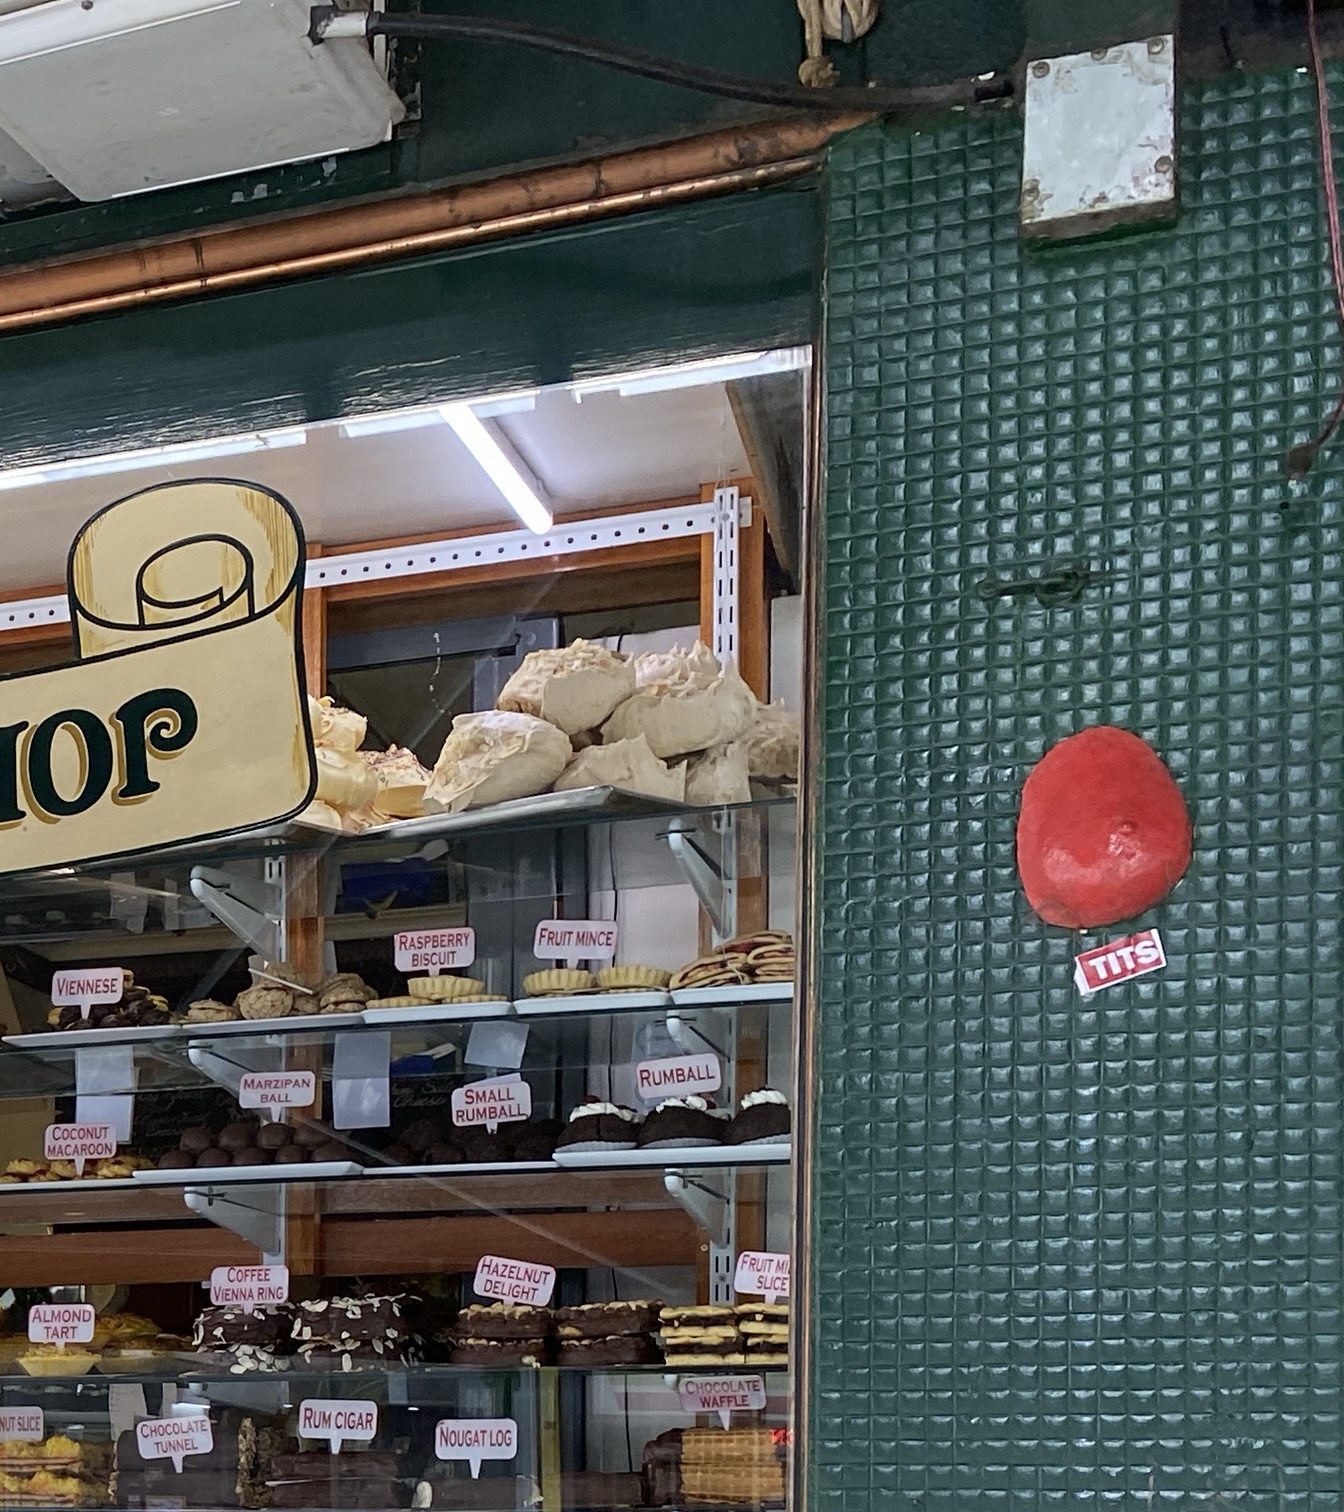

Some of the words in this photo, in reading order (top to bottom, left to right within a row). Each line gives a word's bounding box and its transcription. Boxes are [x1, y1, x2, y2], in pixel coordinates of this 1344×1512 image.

[398, 932, 471, 953] RASPBERRY
[538, 927, 573, 947] FRUIT
[575, 930, 614, 947] MINCE
[411, 950, 457, 966] BISCUIT
[1088, 939, 1161, 981] TITS
[56, 977, 119, 997] VIENNESE
[638, 1063, 716, 1086] RUMBALL
[243, 1078, 311, 1090] MARZIPAN
[259, 1092, 292, 1103] BALL
[463, 1087, 515, 1105] SMALL
[455, 1102, 529, 1123] RUMBALL
[51, 1126, 110, 1142] COCONUT
[47, 1142, 113, 1158] MACAROON
[479, 1257, 549, 1286] HAZELNUT
[740, 1254, 775, 1273] FRUIT
[226, 1267, 272, 1283] COFFEE
[756, 1274, 789, 1292] SLICE
[212, 1285, 254, 1301] VIENNA
[256, 1285, 284, 1301] RING
[483, 1277, 539, 1301] DELIGHT
[31, 1308, 92, 1325] ALMOND
[43, 1326, 79, 1340] TART
[685, 1379, 761, 1394] CHOCOLATE
[699, 1393, 750, 1408] WAFFLE
[16, 1415, 41, 1431] SLICE
[303, 1408, 332, 1430] RUM
[334, 1411, 374, 1431] CIGAR
[140, 1420, 208, 1439] CHOCOLATE
[439, 1429, 485, 1447] NOUGAT
[489, 1428, 512, 1446] LOG
[153, 1438, 199, 1452] TUNNEL
